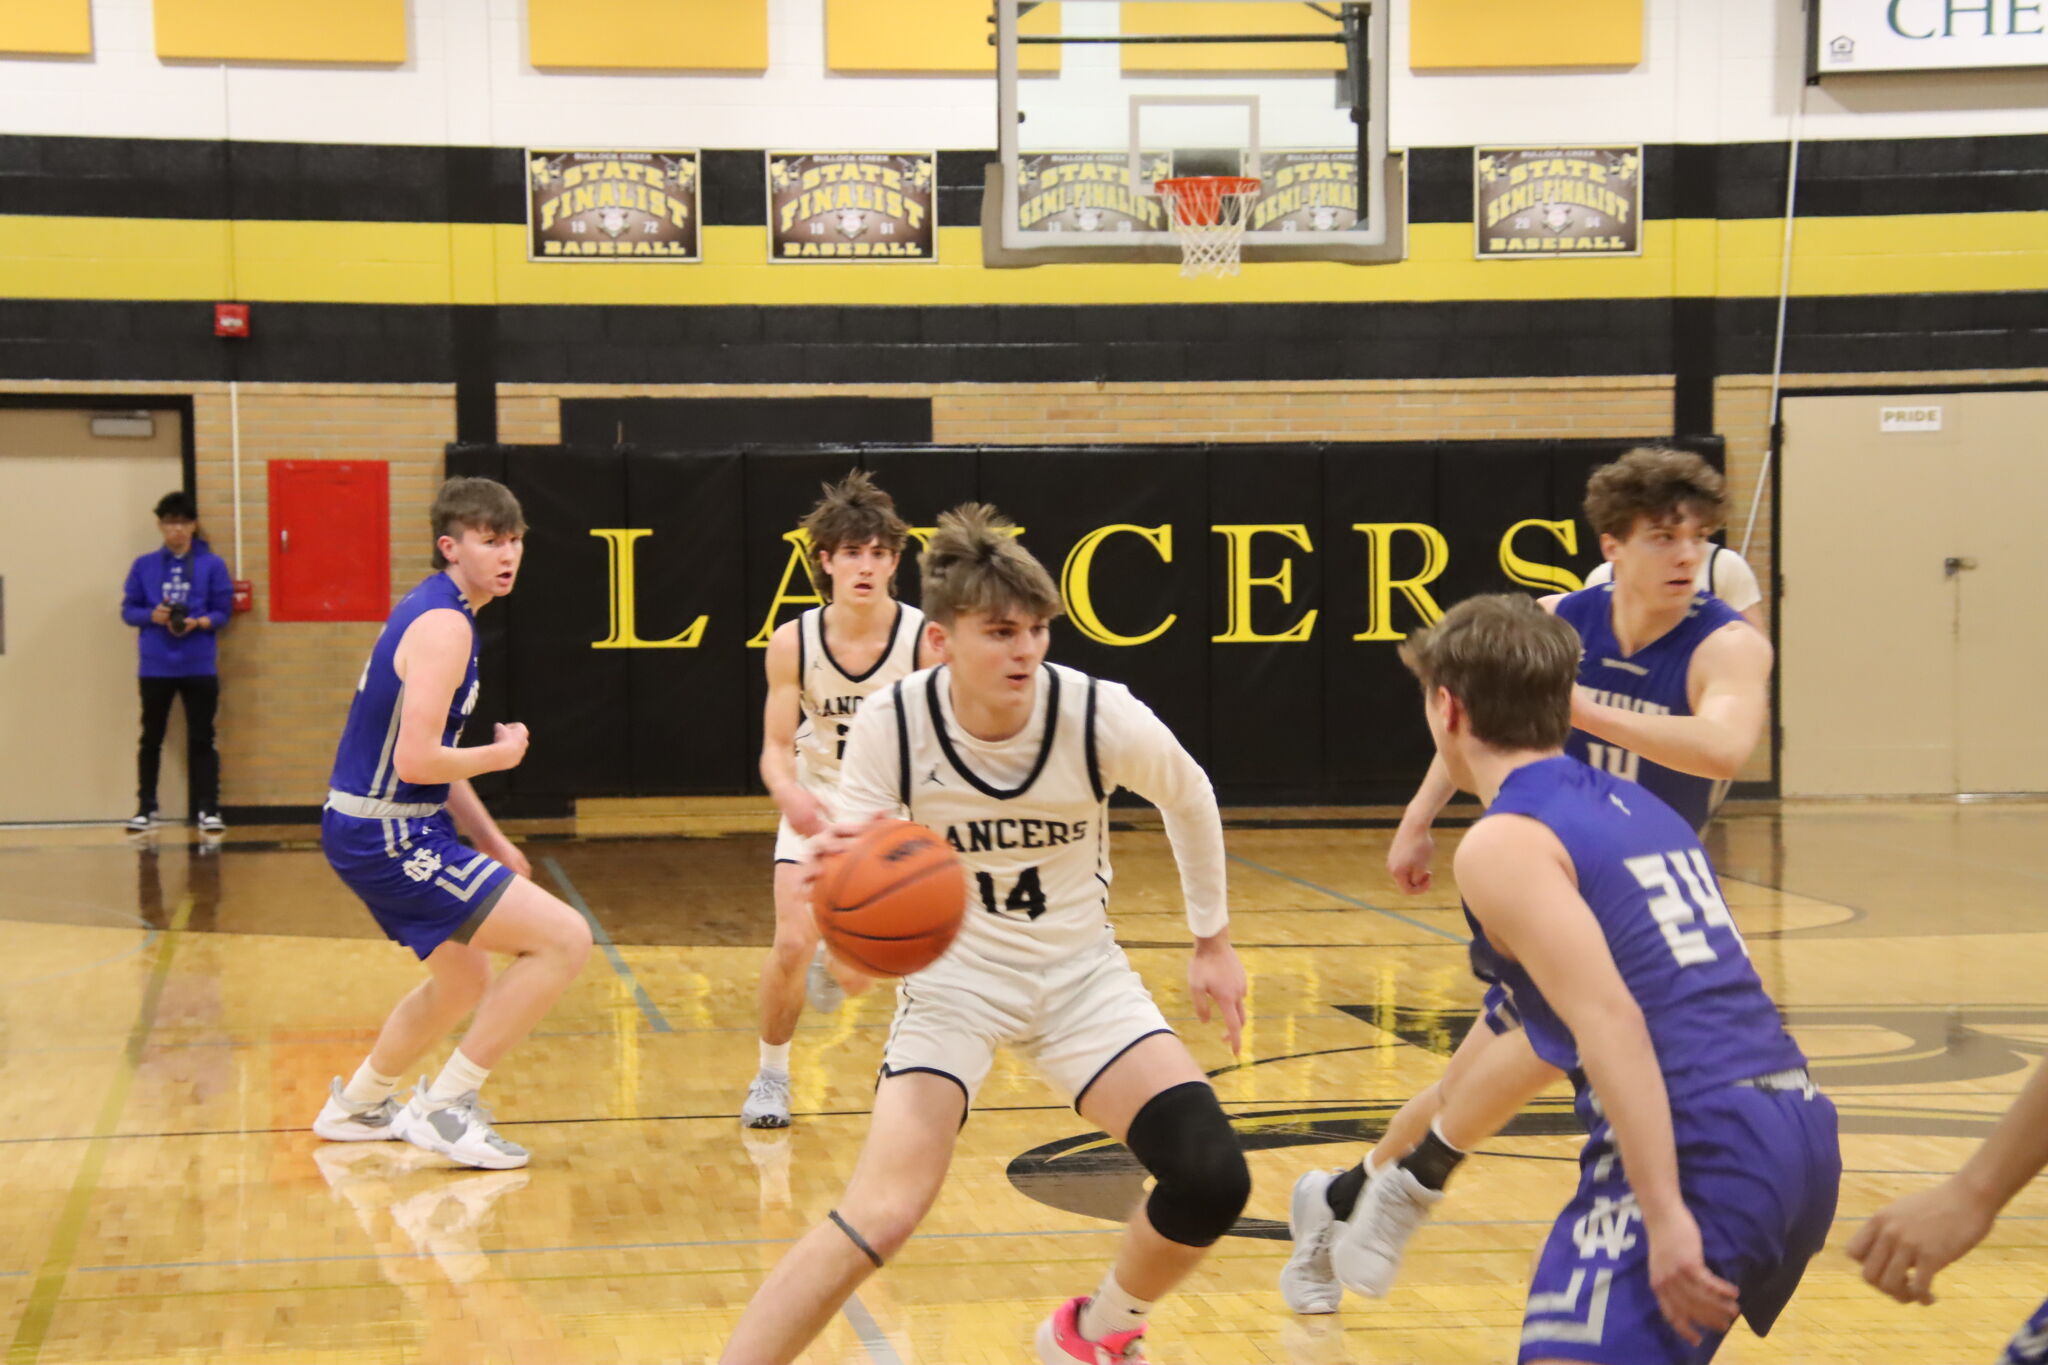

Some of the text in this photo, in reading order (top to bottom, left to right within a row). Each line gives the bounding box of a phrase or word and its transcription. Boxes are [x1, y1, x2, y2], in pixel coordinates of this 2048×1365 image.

[563, 160, 665, 189] STATE
[802, 162, 901, 191] STATE
[1509, 158, 1607, 185] STATE
[541, 181, 688, 231] FINALIST
[780, 183, 924, 233] FINALIST
[1487, 178, 1630, 229] SEMI-FINALIST
[544, 240, 686, 255] BASEBALL
[783, 242, 922, 257] BASEBALL
[1489, 236, 1626, 250] BASEBALL
[1883, 409, 1937, 422] PRIDE
[945, 818, 1088, 853] ANCERS
[975, 866, 1047, 920] 14
[1623, 848, 1749, 968] 24
